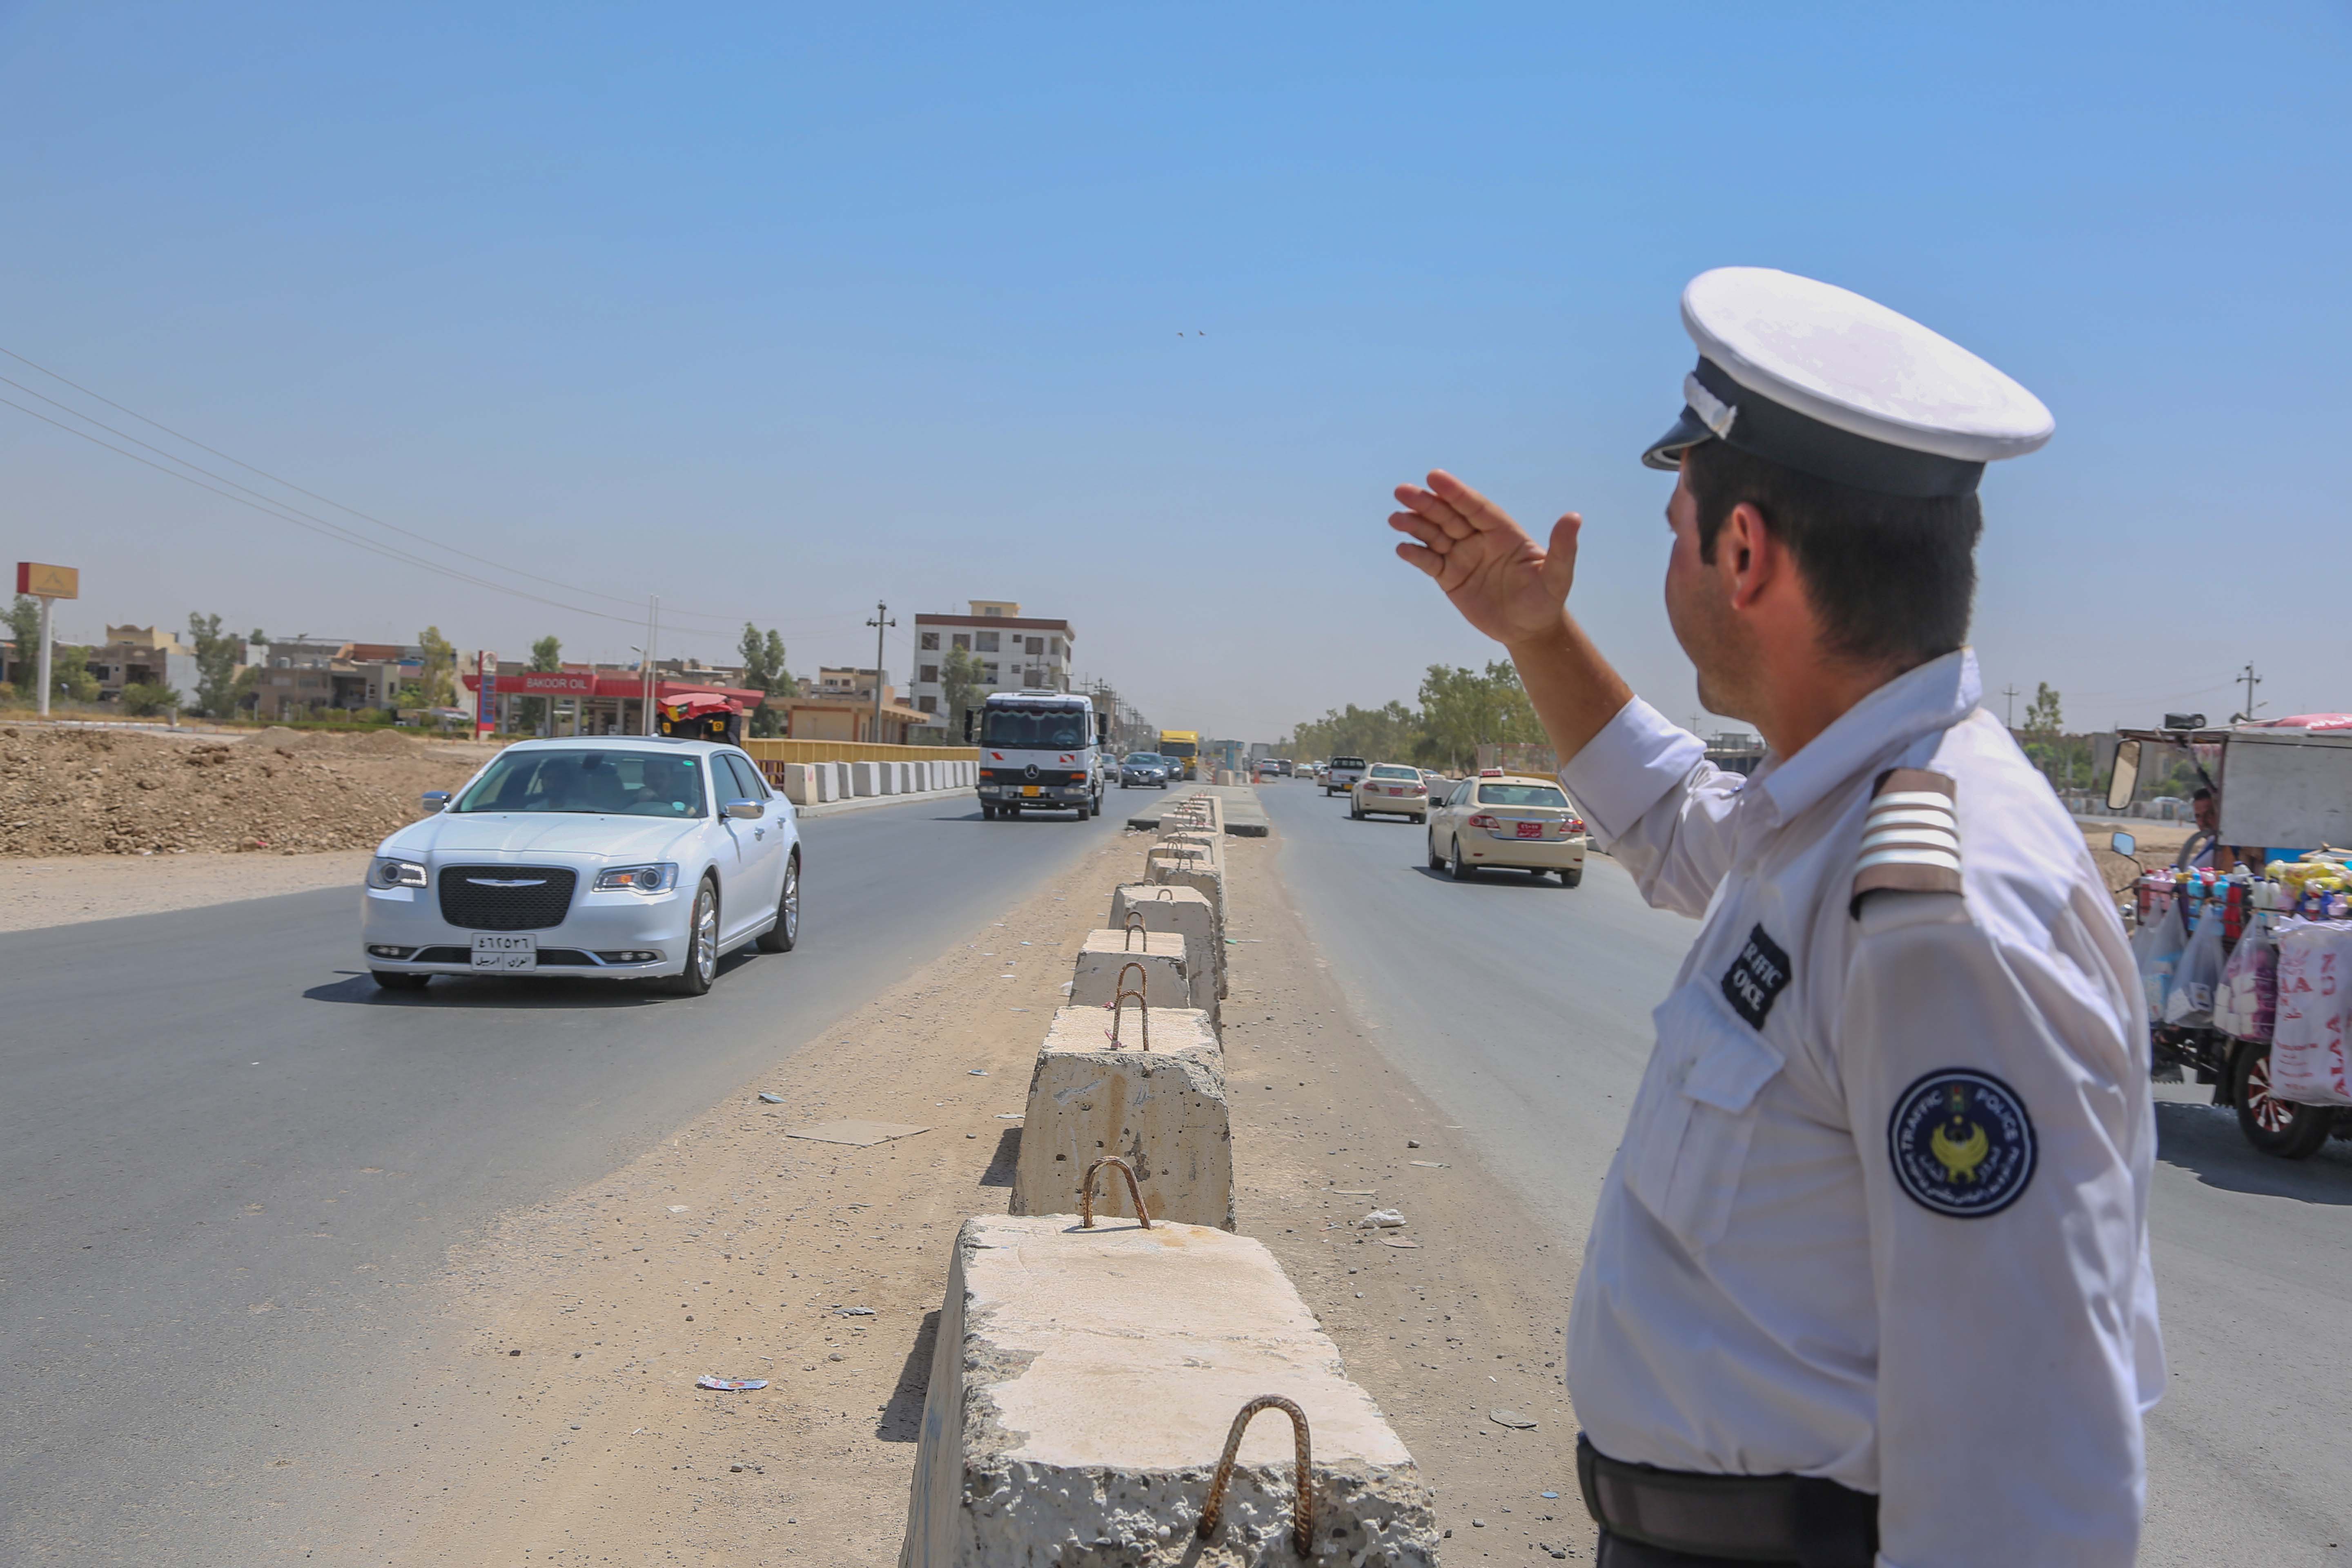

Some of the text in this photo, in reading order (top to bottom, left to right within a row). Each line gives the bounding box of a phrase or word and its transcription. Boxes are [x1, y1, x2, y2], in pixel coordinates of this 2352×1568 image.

[526, 677, 587, 689] BAKOOR OIL
[1901, 1088, 2018, 1151] TRAFFIC POLICE
